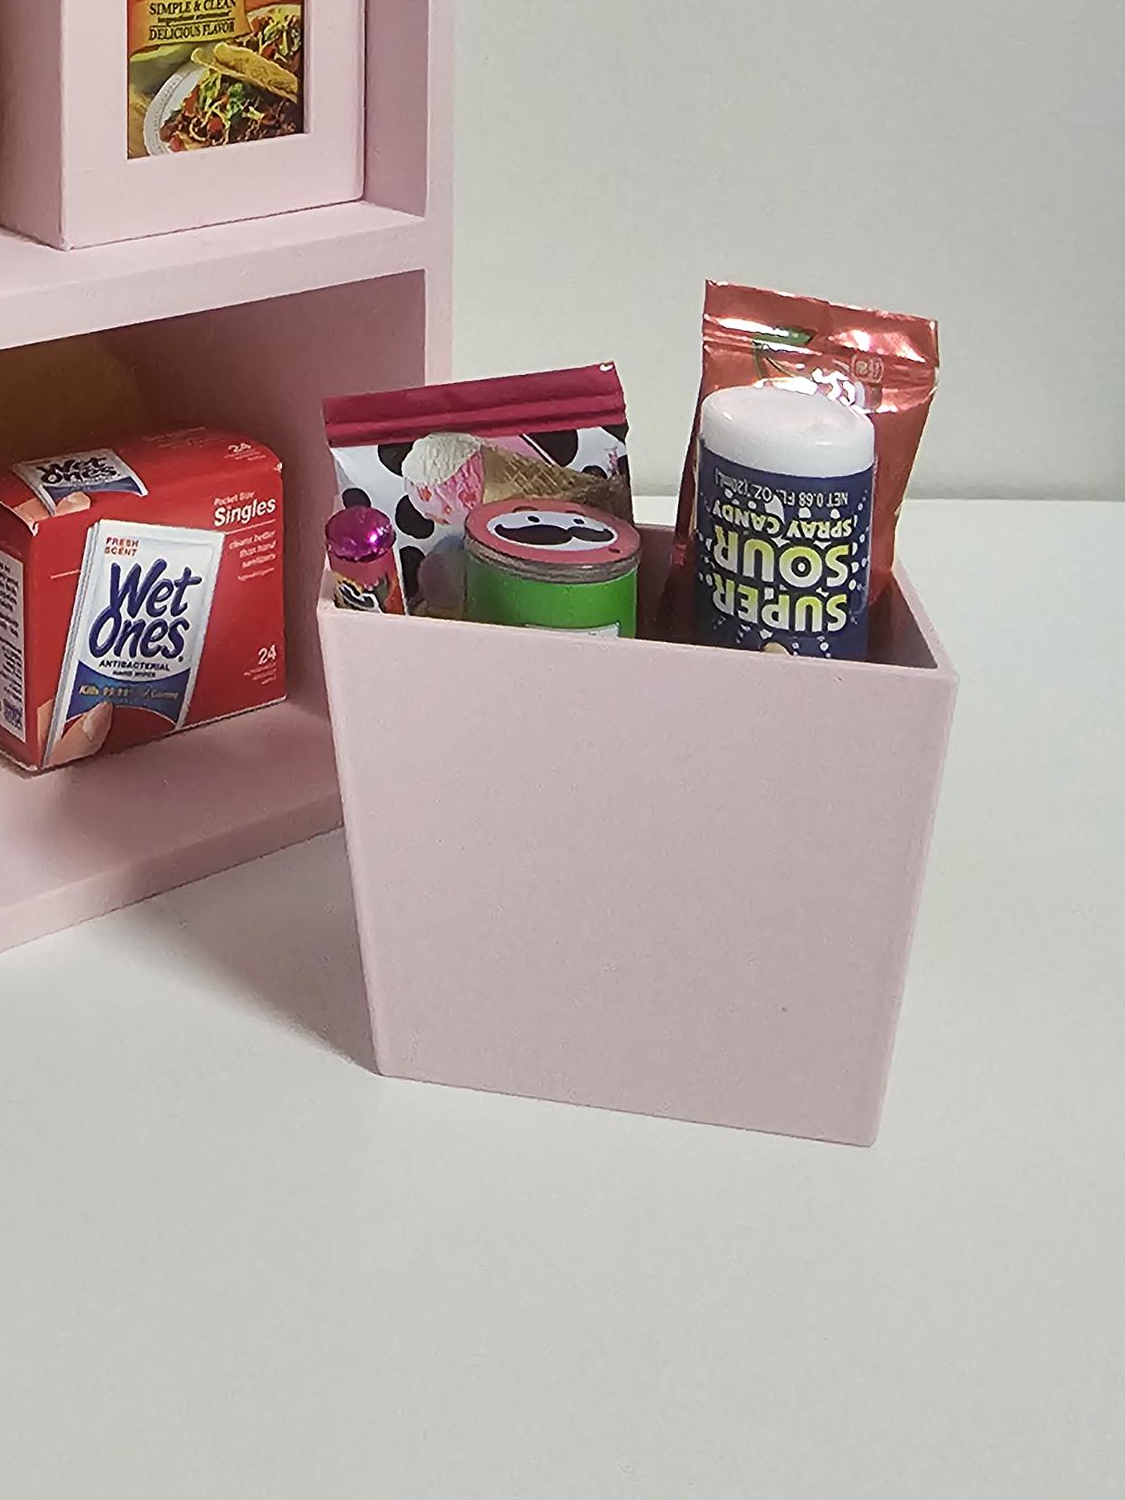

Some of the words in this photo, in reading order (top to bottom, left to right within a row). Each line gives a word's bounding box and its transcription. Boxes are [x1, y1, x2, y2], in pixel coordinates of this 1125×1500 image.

[149, 1, 191, 16] SIMPLE
[194, 1, 202, 13] &
[149, 25, 201, 41] DELICIOUS
[202, 21, 235, 38] FLAVOR
[798, 490, 824, 508] 0.68
[826, 491, 849, 508] NET
[214, 499, 276, 527] Singles
[712, 499, 781, 535] CANDY
[786, 518, 852, 539] SPRAY
[104, 546, 138, 557] SCENT
[105, 537, 139, 548] FRESH
[713, 524, 851, 587] SOUR
[110, 558, 203, 619] Wet
[712, 573, 847, 633] SUPER
[88, 604, 190, 659] Ones
[258, 644, 277, 665] 24
[99, 659, 171, 672] ANTIBACTERIAL
